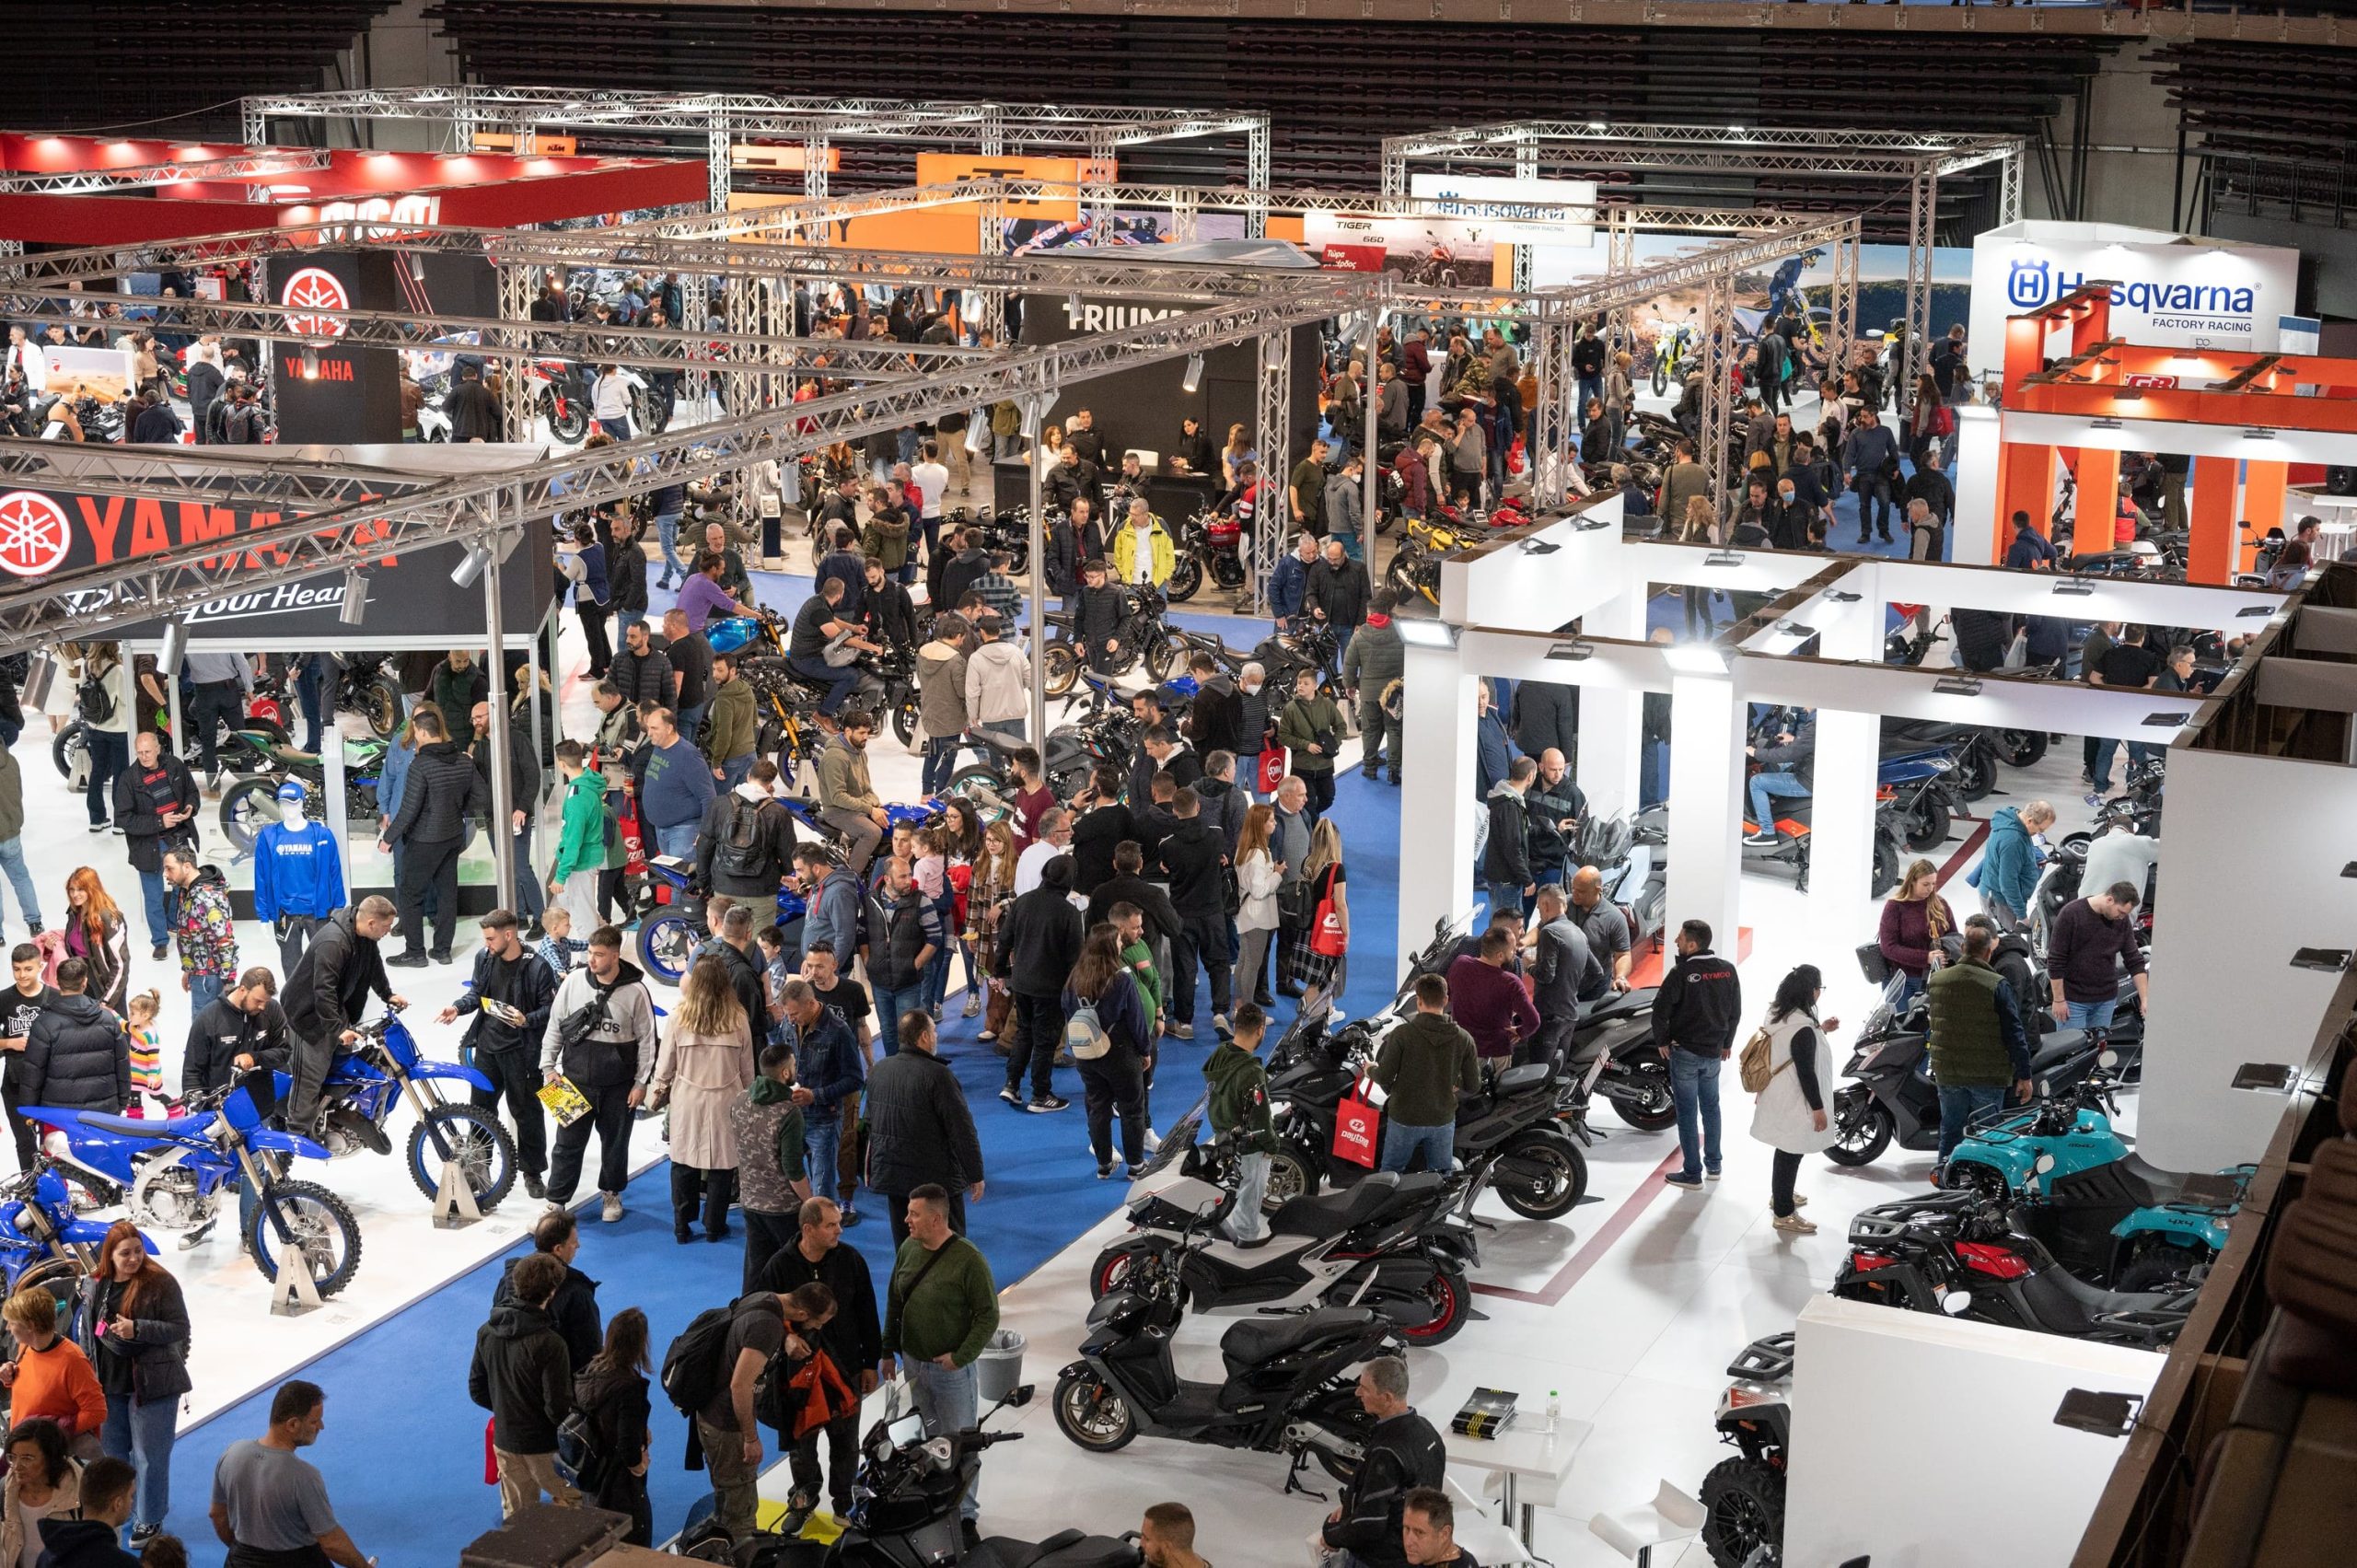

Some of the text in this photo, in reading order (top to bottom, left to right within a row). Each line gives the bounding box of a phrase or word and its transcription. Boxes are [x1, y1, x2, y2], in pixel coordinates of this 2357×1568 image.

[1337, 221, 1372, 230] TIGER
[2058, 272, 2254, 314] Hsqvarna
[2153, 318, 2252, 332] FACTORY RACING
[285, 356, 354, 381] YAAHA
[275, 583, 354, 608] Hear
[284, 843, 313, 853] YAMAHA
[1702, 971, 1731, 981] KYMCO
[595, 1019, 621, 1034] das
